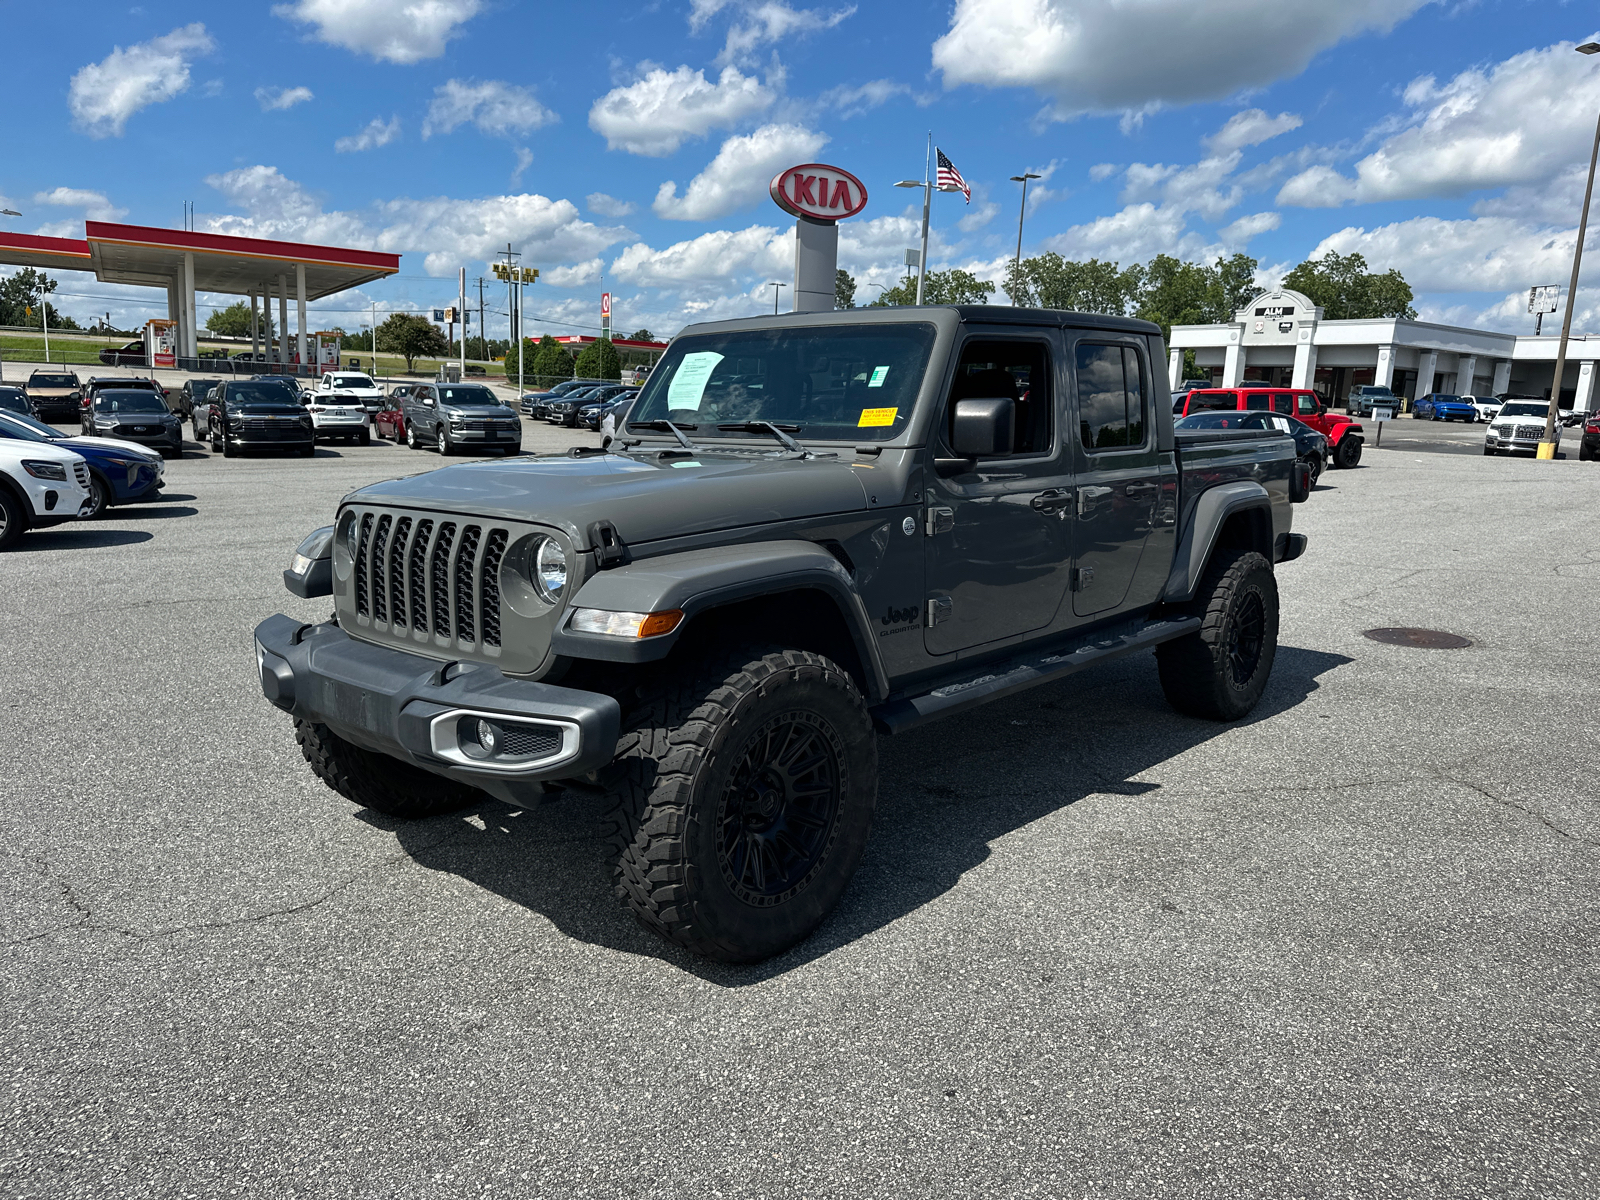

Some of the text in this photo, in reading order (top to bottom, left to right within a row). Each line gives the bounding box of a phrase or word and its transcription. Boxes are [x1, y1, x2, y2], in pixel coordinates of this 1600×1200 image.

[793, 174, 853, 211] KIA
[493, 264, 538, 276] WALE
[1264, 307, 1283, 316] ALM
[881, 606, 919, 625] Jeep
[880, 624, 920, 637] GLADIATOR
